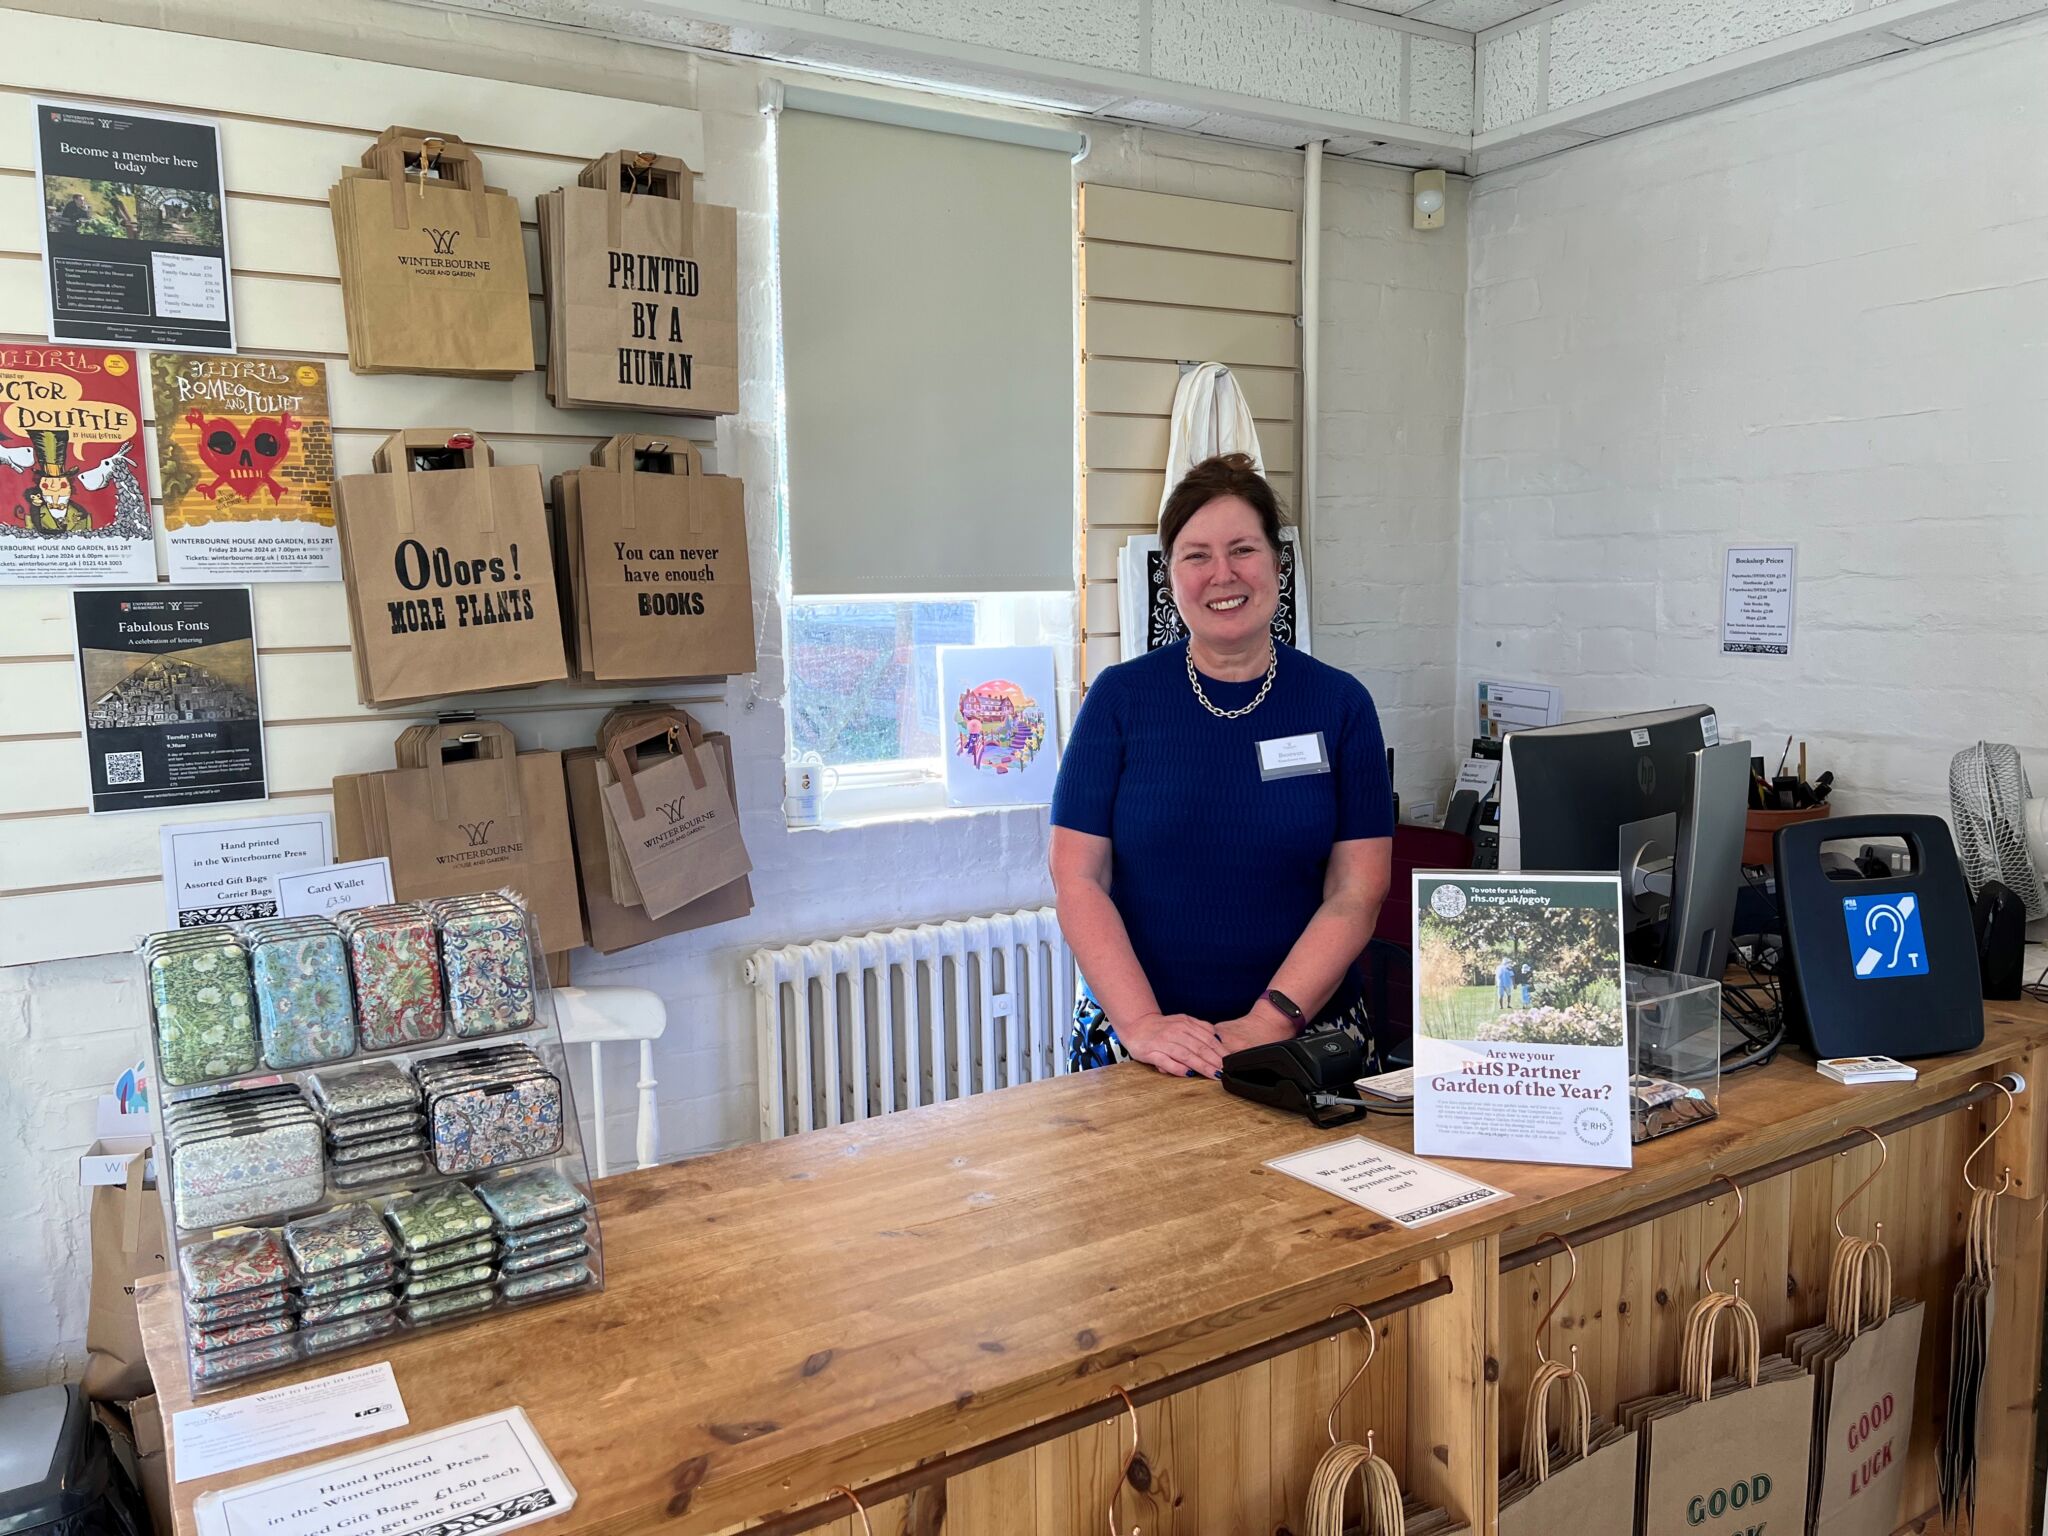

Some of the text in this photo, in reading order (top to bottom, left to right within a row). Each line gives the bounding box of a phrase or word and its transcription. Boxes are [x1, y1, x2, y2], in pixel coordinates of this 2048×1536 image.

[60, 142, 198, 168] Become a member here
[114, 161, 146, 175] today
[398, 255, 491, 272] WINTERBOURNE
[415, 268, 476, 278] HOUSE AND GARDEN
[608, 250, 699, 298] PRINTED
[632, 302, 683, 343] BY A
[617, 348, 694, 390] HUMAN
[176, 376, 246, 401] ROMEO
[226, 390, 304, 415] AND JULIET
[17, 406, 128, 431] DOLITTLE
[614, 541, 719, 562] You can never
[1736, 558, 1764, 566] Bookshop
[624, 564, 715, 585] have enough
[388, 588, 534, 634] MORE PLANTS
[638, 592, 705, 616] BOOKS
[118, 620, 210, 632] Fabulous Fonts
[644, 810, 716, 850] WINTERBOURNE
[658, 825, 706, 850] HOUSE AND GARDEN
[220, 838, 280, 850] Hand printed
[436, 842, 524, 866] WINTERBOURNE
[194, 849, 307, 867] in the Winterbourne Press
[452, 856, 510, 870] HOUSE AND GARDEN
[184, 874, 268, 890] Assorted Gift Bags
[217, 887, 272, 900] Carrier Bags
[307, 878, 364, 895] Card Wallet
[326, 895, 351, 908] £3.50
[1470, 895, 1551, 906] rhs.org.uk/pgoty
[1908, 953, 1918, 968] T
[1486, 1049, 1555, 1062] Are we your
[1461, 1060, 1581, 1080] RHS Partner
[1431, 1077, 1612, 1100] Garden of the Year?
[1590, 1122, 1607, 1130] RHS
[1316, 1155, 1383, 1178] We are only
[1340, 1163, 1396, 1183] accepting
[1348, 1168, 1418, 1194] payments by
[1388, 1181, 1414, 1193] card
[256, 1366, 384, 1402] Want to keep in touch?
[1848, 1392, 1895, 1453] GOOD
[318, 1456, 433, 1495] Hand printed
[1850, 1436, 1895, 1499] LUCK
[267, 1453, 491, 1528] in the Winterbourne Press
[337, 1465, 521, 1528] Gift Bags £1.50 each
[1686, 1473, 1772, 1526] GOOD
[381, 1491, 488, 1534] get one free!
